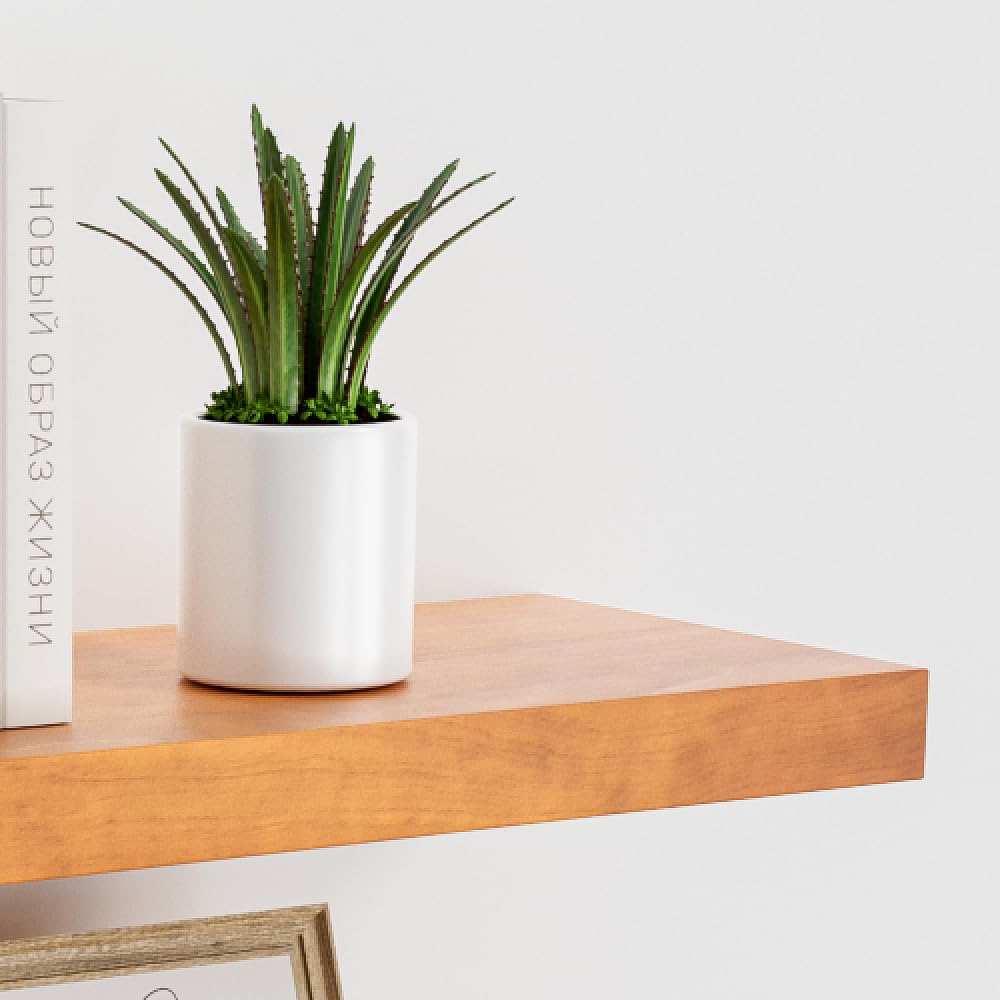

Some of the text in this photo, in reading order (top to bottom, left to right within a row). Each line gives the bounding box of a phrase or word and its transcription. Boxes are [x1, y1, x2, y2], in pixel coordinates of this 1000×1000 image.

[27, 187, 59, 647] НОВЫЙ ОБРАЗ ЖИЗНИ
